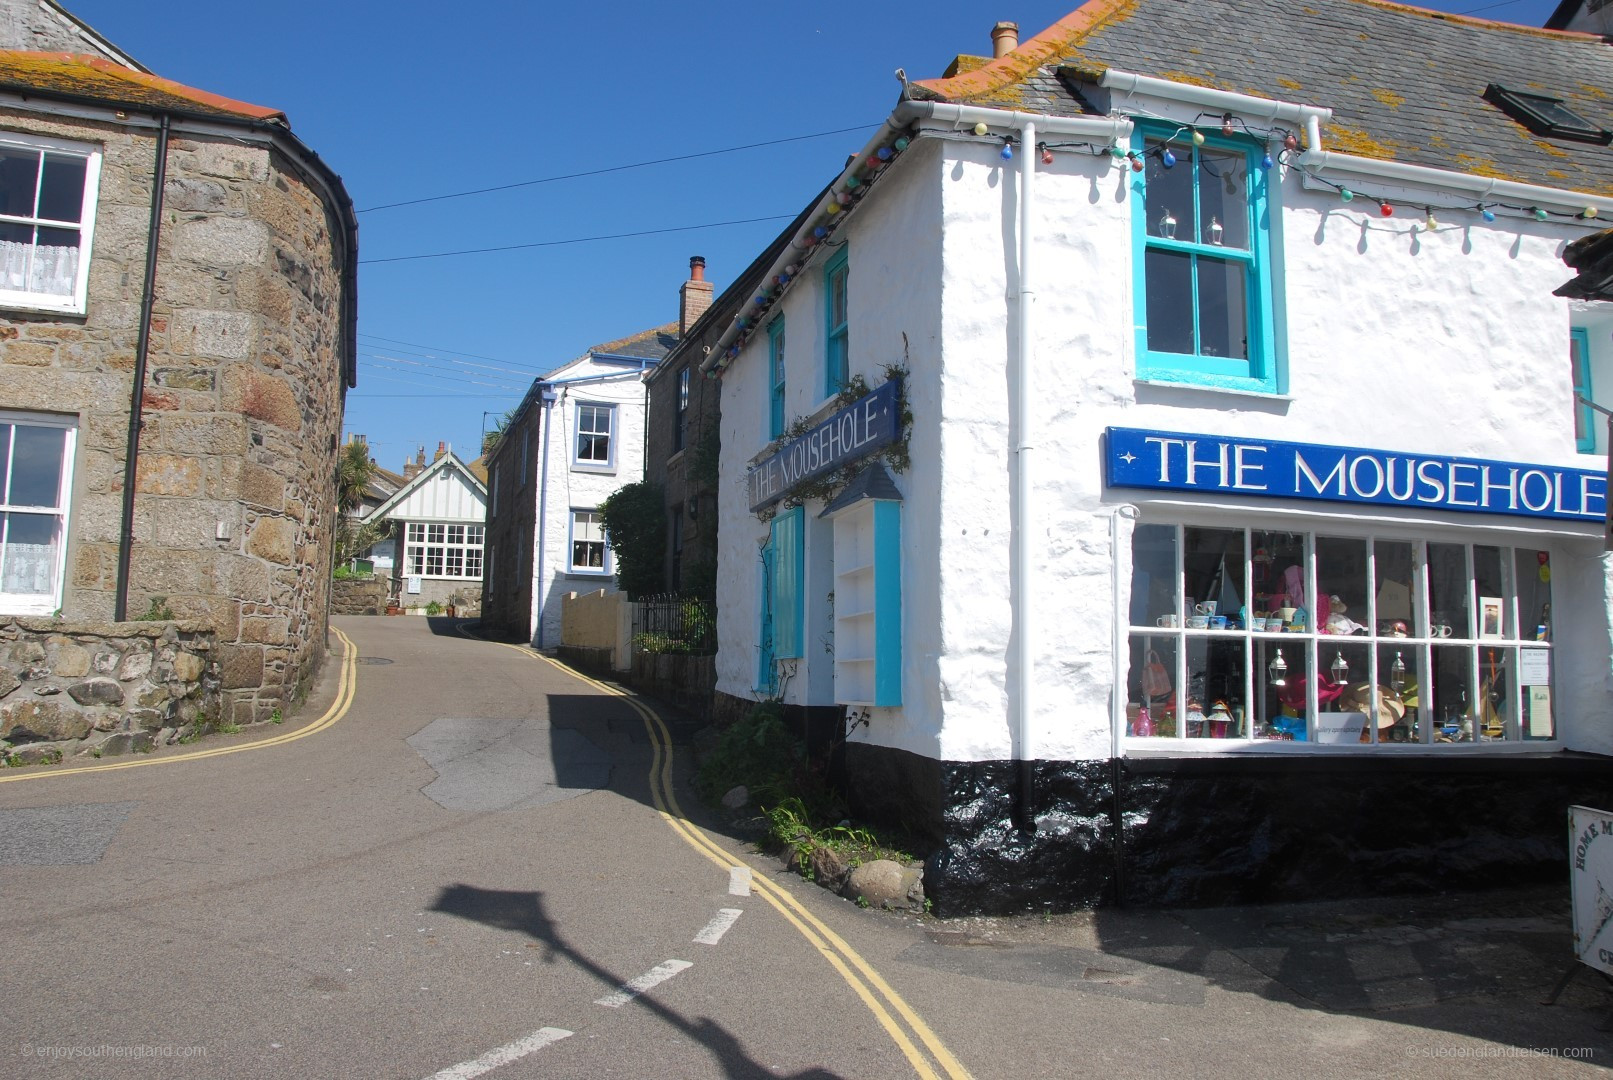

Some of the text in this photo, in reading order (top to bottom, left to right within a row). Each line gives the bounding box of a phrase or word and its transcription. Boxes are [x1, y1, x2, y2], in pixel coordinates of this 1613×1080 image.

[753, 395, 878, 502] THE MOUSEHOLE
[1145, 436, 1607, 517] THE MOUSEHOLE
[1575, 822, 1600, 872] HOME
